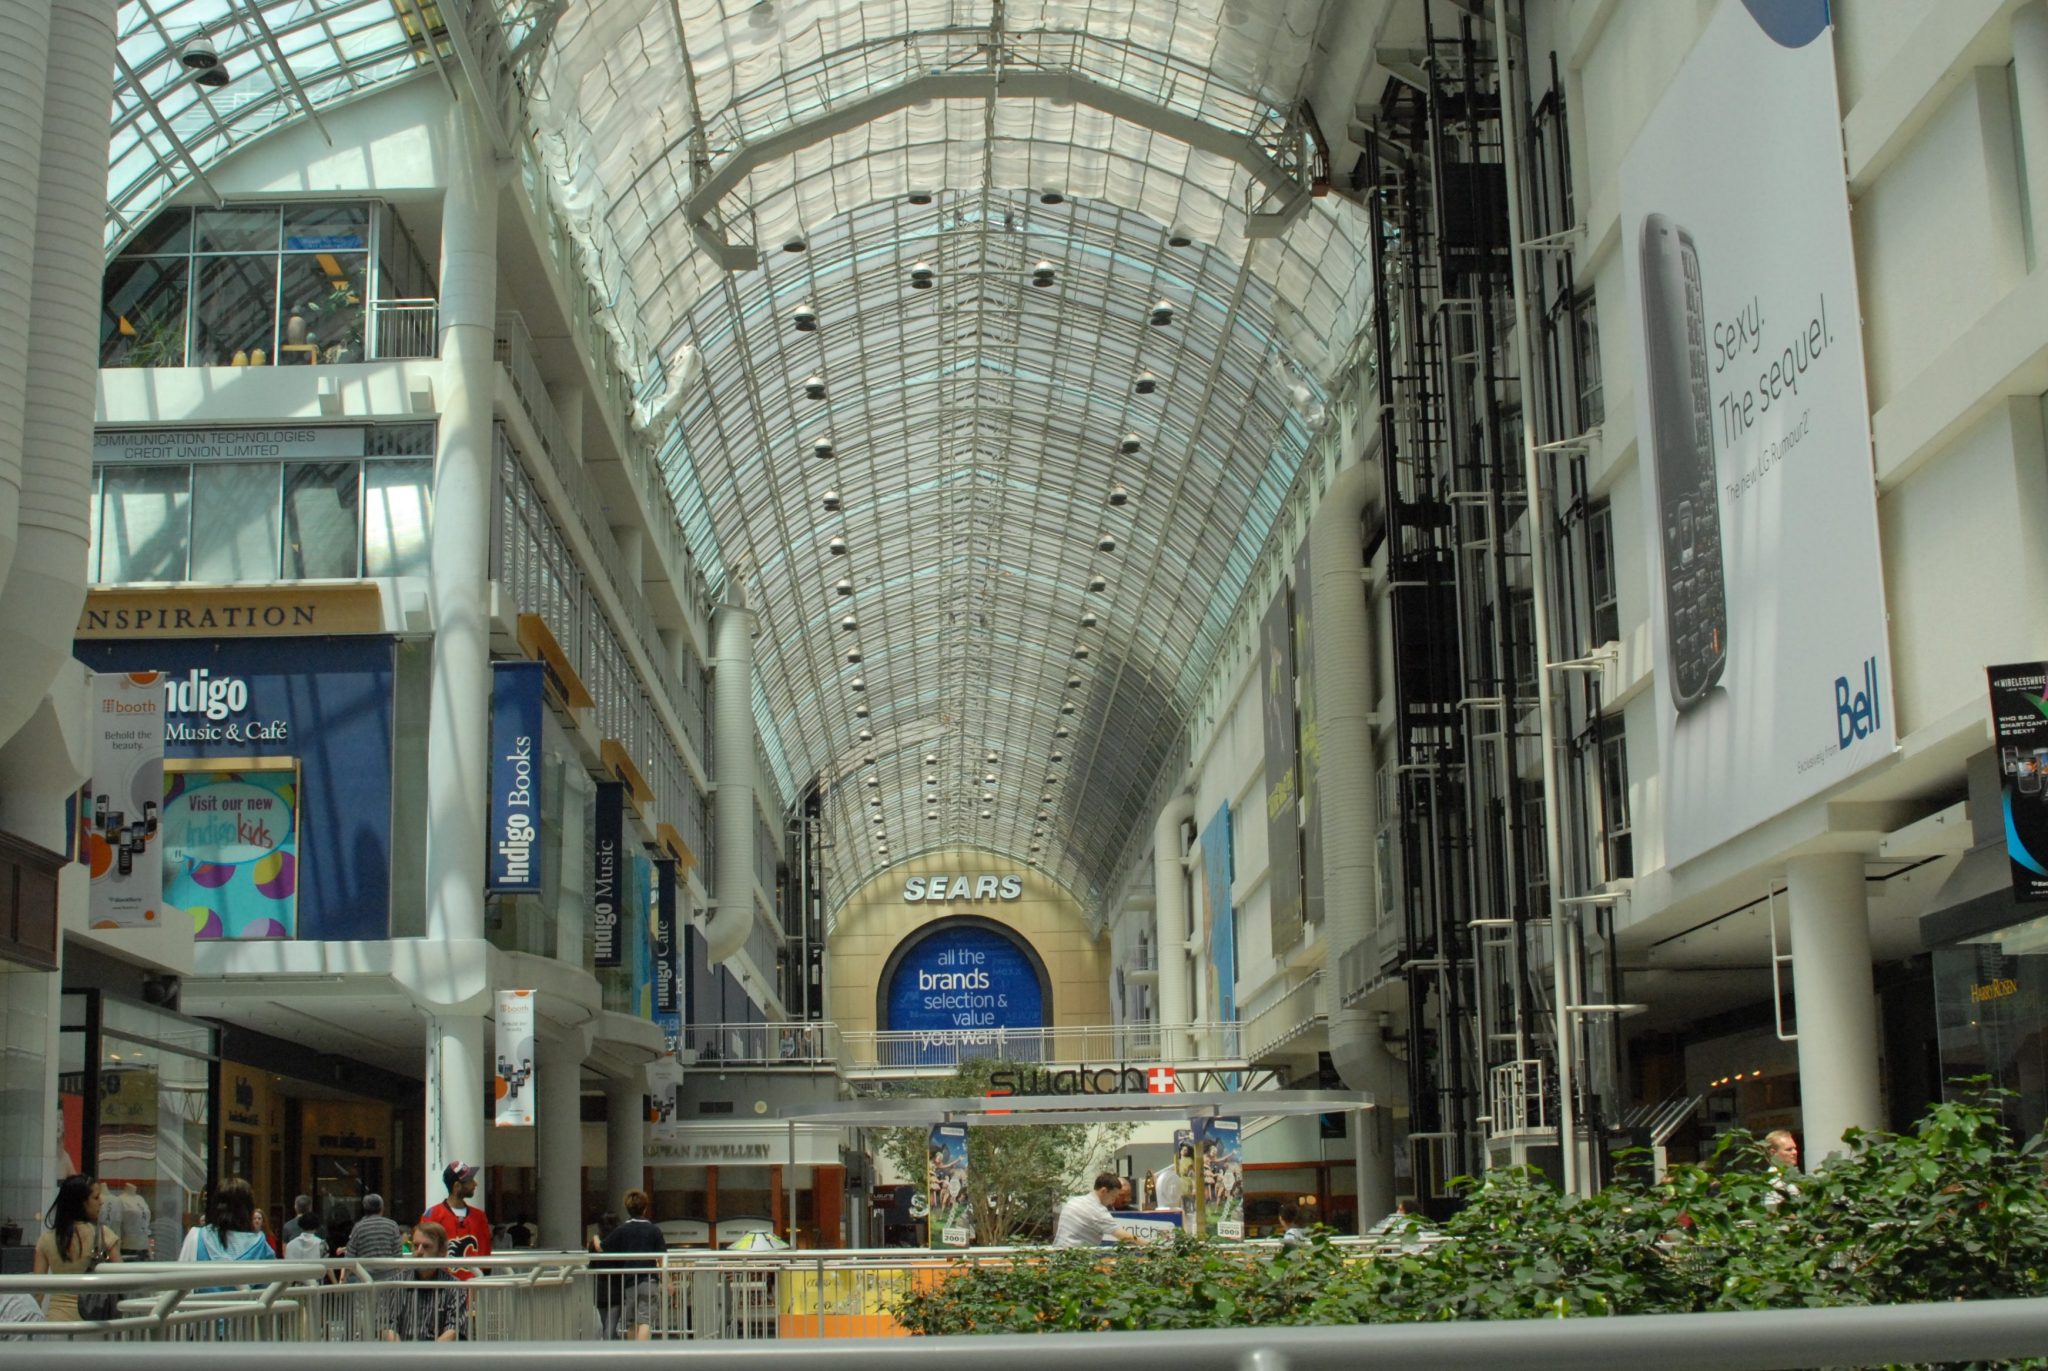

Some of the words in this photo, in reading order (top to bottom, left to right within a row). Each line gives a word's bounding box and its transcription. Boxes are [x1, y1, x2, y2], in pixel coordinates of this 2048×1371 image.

[1714, 296, 1765, 373] Sexy.
[1719, 390, 1754, 448] The
[1759, 293, 1834, 412] sequel.
[210, 431, 316, 444] TECHNOLOGIES
[124, 447, 171, 459] CREDIT
[177, 446, 222, 458] UNION
[226, 445, 280, 457] LIMITED
[1757, 449, 1770, 477] LG
[77, 605, 316, 631] NSPIRATION
[164, 669, 248, 720] ndigo
[1835, 656, 1880, 750] Bell
[104, 731, 135, 740] Behold
[137, 730, 152, 739] the
[165, 723, 221, 741] Music
[225, 724, 245, 742] &
[245, 720, 287, 741] Café
[507, 735, 531, 807] Books
[189, 795, 217, 811] Visit
[222, 799, 243, 811] our
[247, 799, 273, 811] new
[595, 839, 614, 898] Music
[903, 874, 1022, 901] SEARS
[937, 949, 955, 966] all
[958, 948, 985, 965] the
[919, 968, 990, 991] brands
[924, 992, 995, 1010] selection
[997, 993, 1008, 1008] &
[952, 1009, 995, 1026] value
[987, 1062, 1149, 1097] swatch
